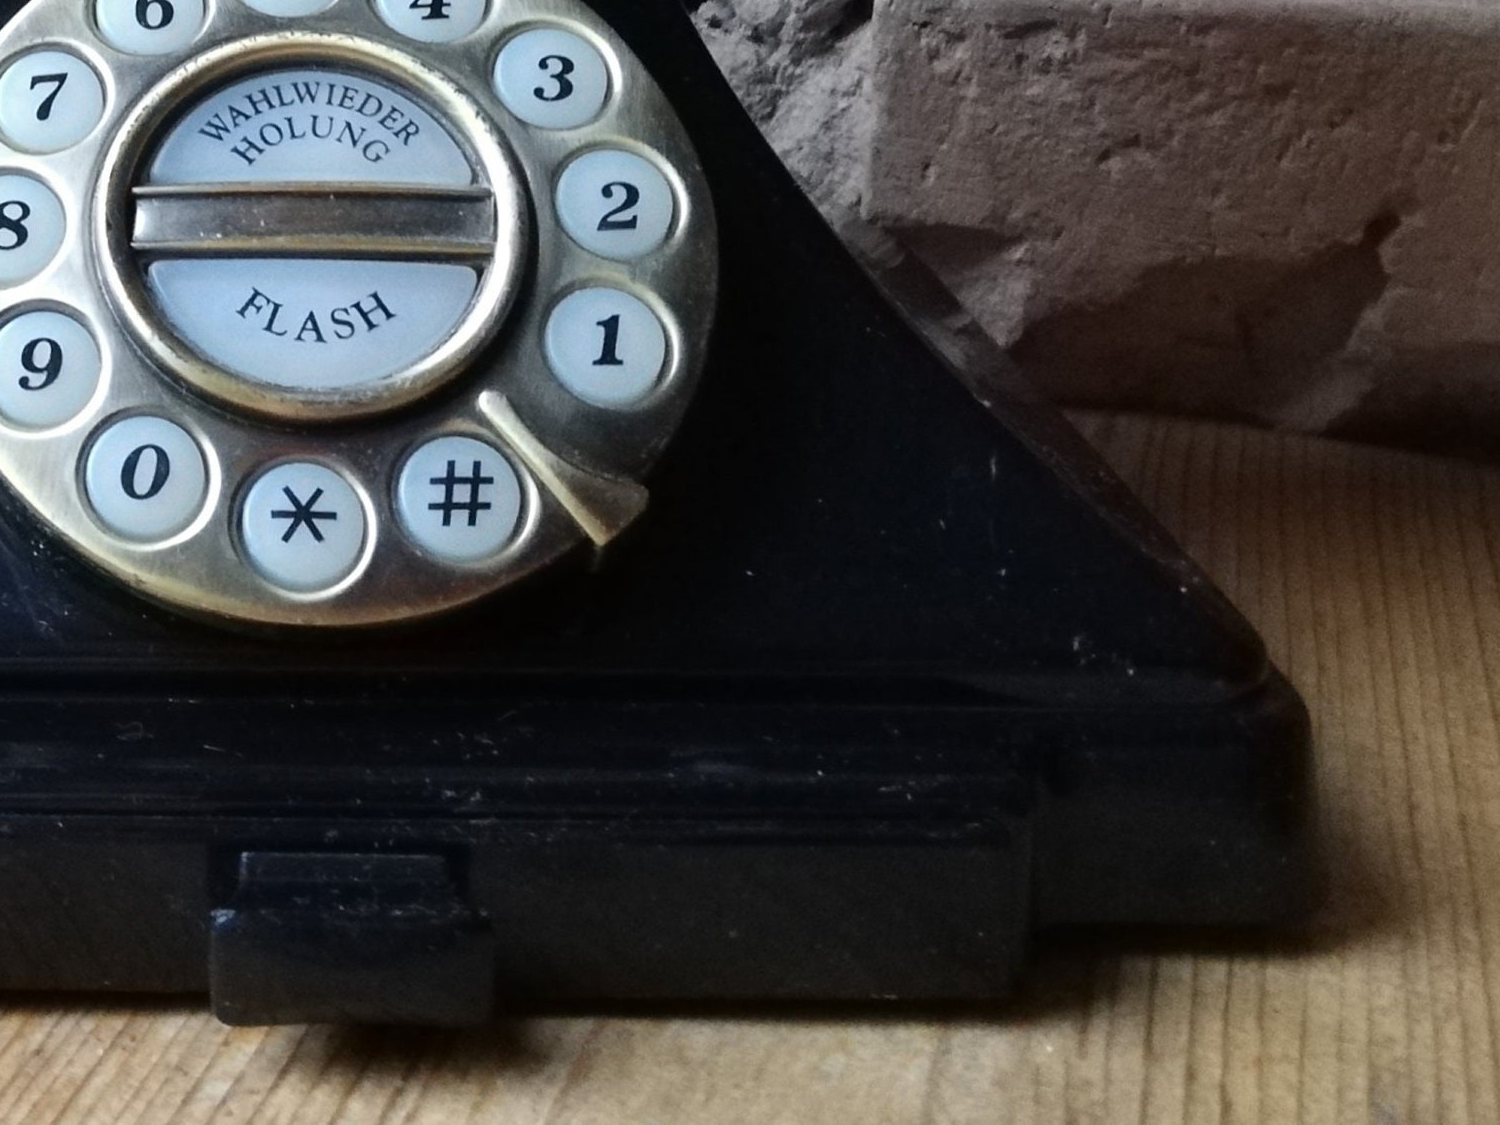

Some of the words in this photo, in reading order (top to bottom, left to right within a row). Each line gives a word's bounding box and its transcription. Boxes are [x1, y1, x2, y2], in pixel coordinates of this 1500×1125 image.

[29, 72, 68, 121] 7
[533, 55, 575, 102] 3
[198, 81, 420, 147] WAHLWIEDER
[230, 114, 391, 166] HOLUNG
[596, 181, 640, 232] 2
[236, 286, 397, 344] FLASH
[591, 314, 624, 366] 1
[18, 337, 63, 391] 9
[120, 444, 170, 501] 0
[427, 459, 495, 527] #
